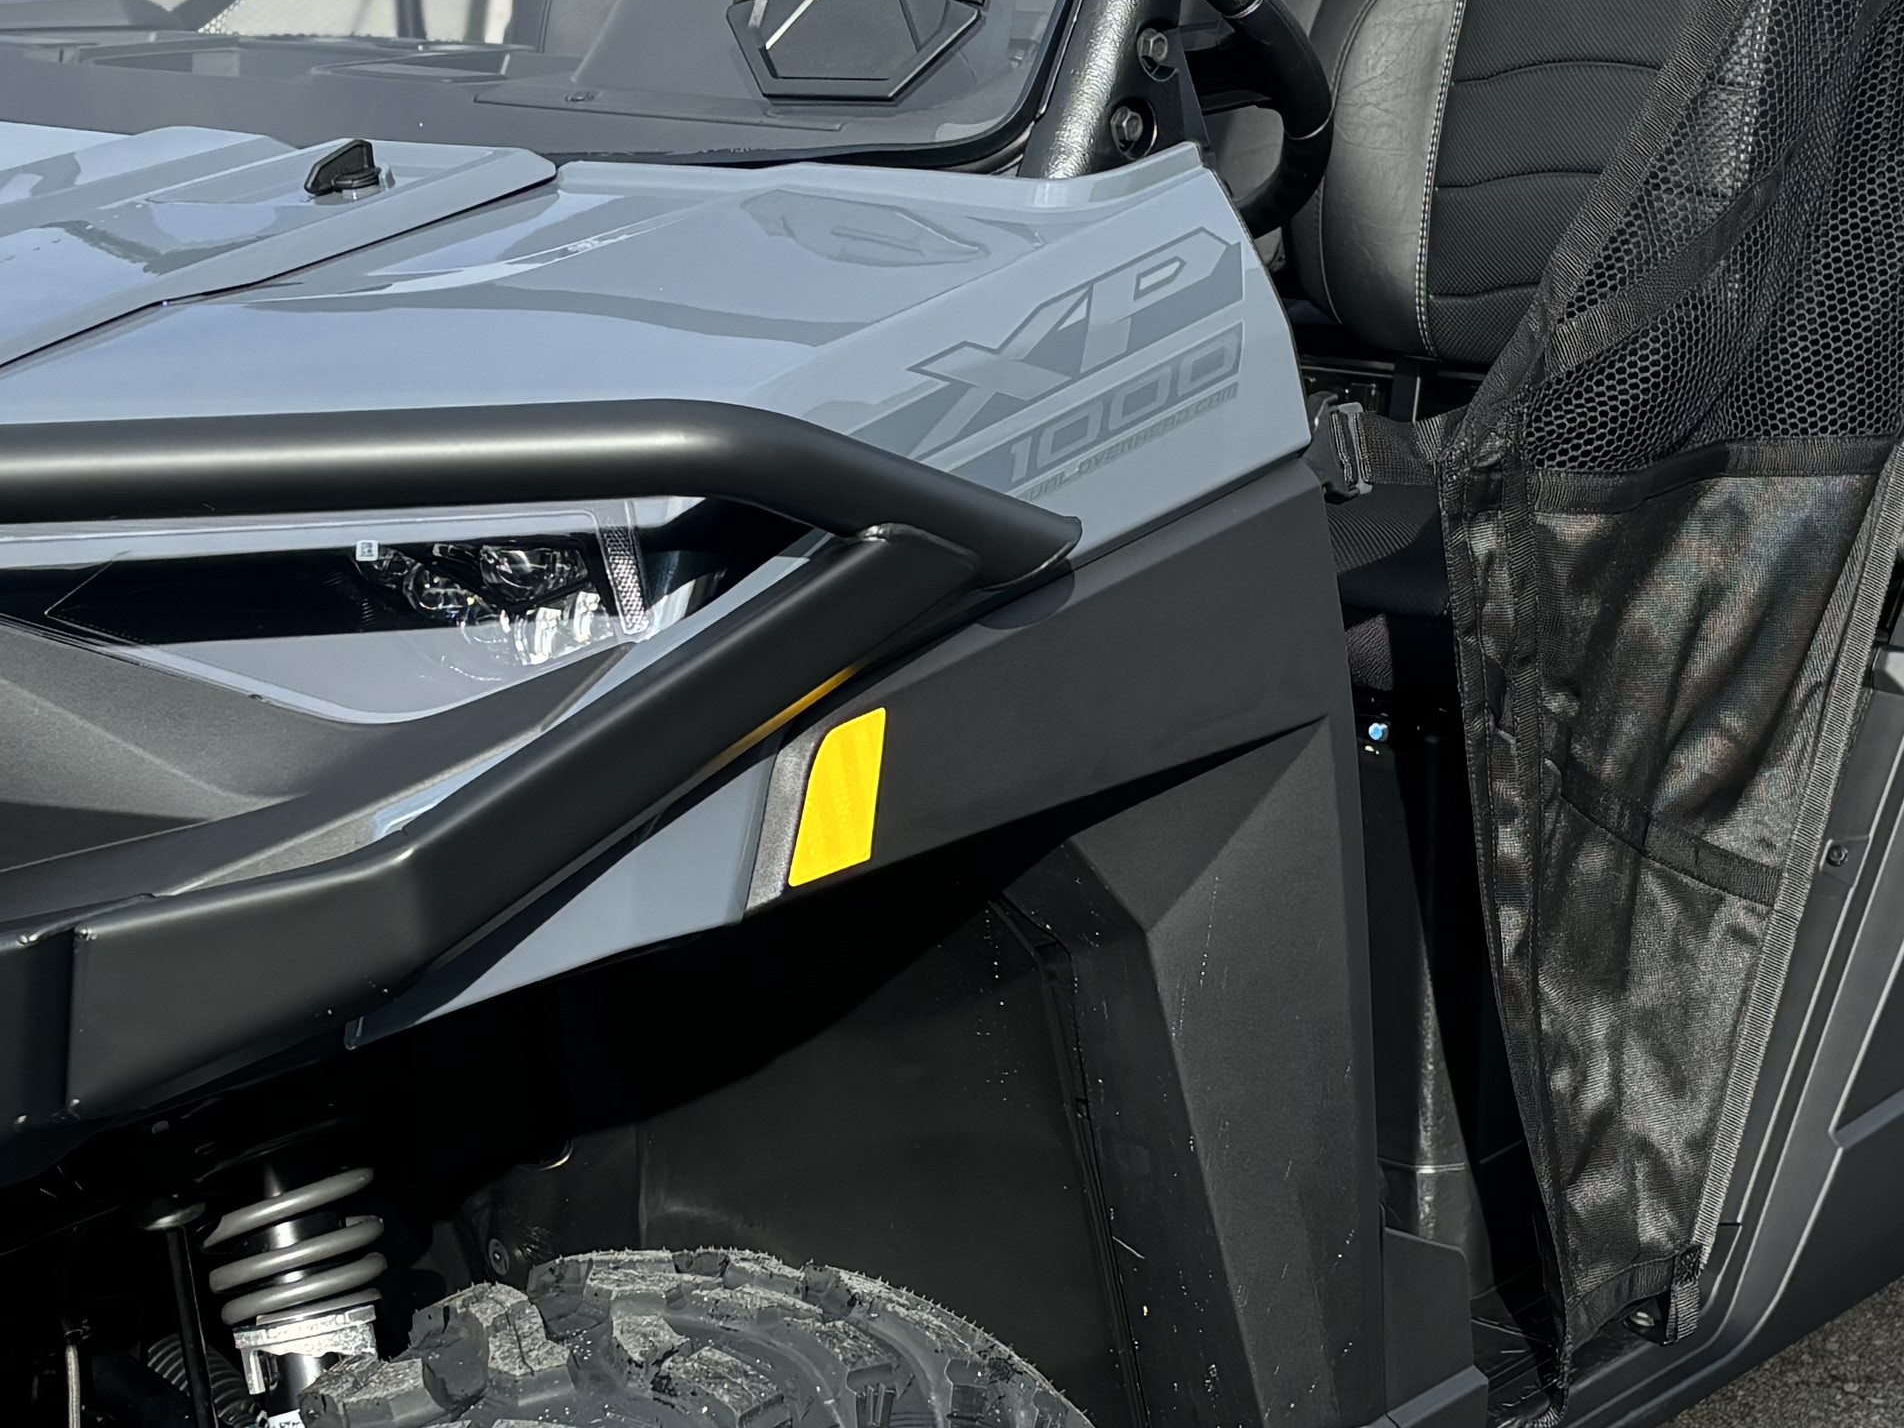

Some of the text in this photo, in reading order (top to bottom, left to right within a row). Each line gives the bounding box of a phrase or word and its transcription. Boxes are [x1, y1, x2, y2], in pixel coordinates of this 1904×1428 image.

[886, 226, 1243, 460] XP
[1008, 325, 1242, 484] 1000
[1077, 408, 1192, 475] OVERHEAD
[1193, 382, 1240, 416] CAM
